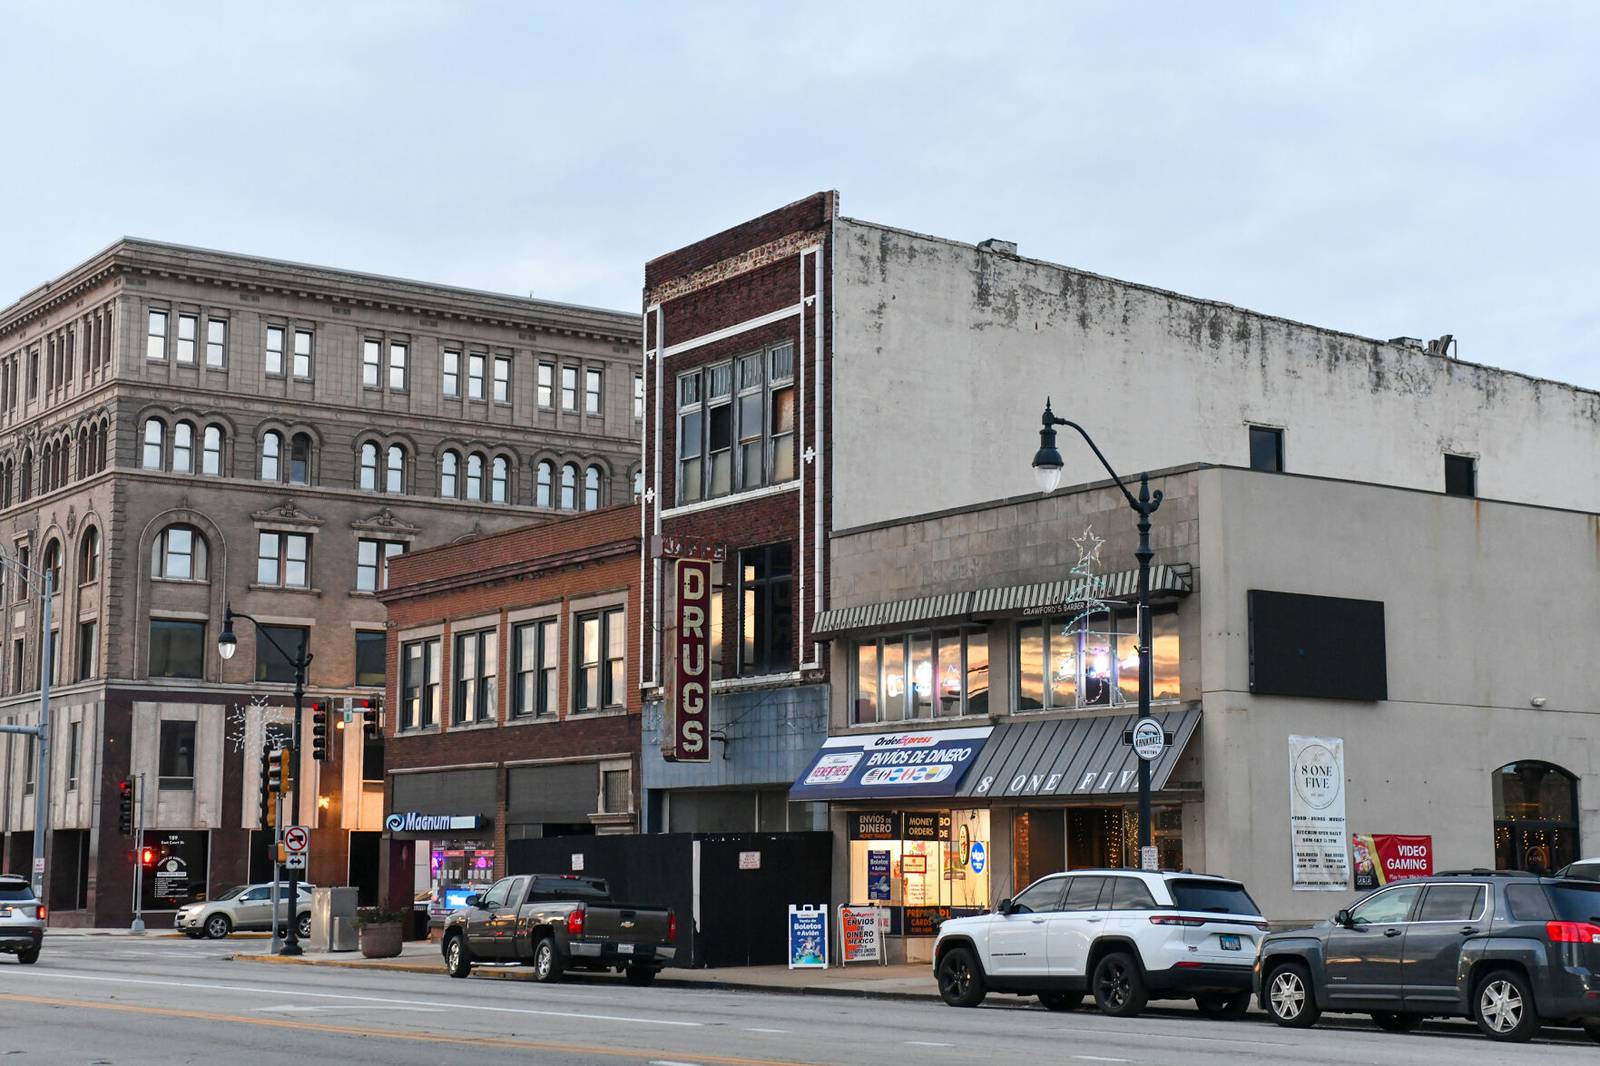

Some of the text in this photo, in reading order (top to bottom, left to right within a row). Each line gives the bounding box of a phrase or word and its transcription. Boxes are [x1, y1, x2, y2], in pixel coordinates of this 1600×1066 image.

[1023, 604, 1063, 615] CRAWFORD'S
[1063, 602, 1085, 611] BARBER
[682, 567, 705, 752] DRUGS
[867, 748, 972, 766] ENVÍOS DE DINERO
[1301, 765, 1332, 776] 8 ONE
[977, 770, 1152, 793] 8 ONE FIV
[1305, 777, 1330, 789] FIVE
[405, 812, 450, 831] Magnum
[909, 817, 933, 825] MONEY
[860, 824, 892, 833] DINERO
[909, 827, 934, 835] ORDERS
[1398, 845, 1427, 857] VIDEO
[1387, 858, 1428, 870] GAMING
[847, 918, 875, 926] ENVIOS
